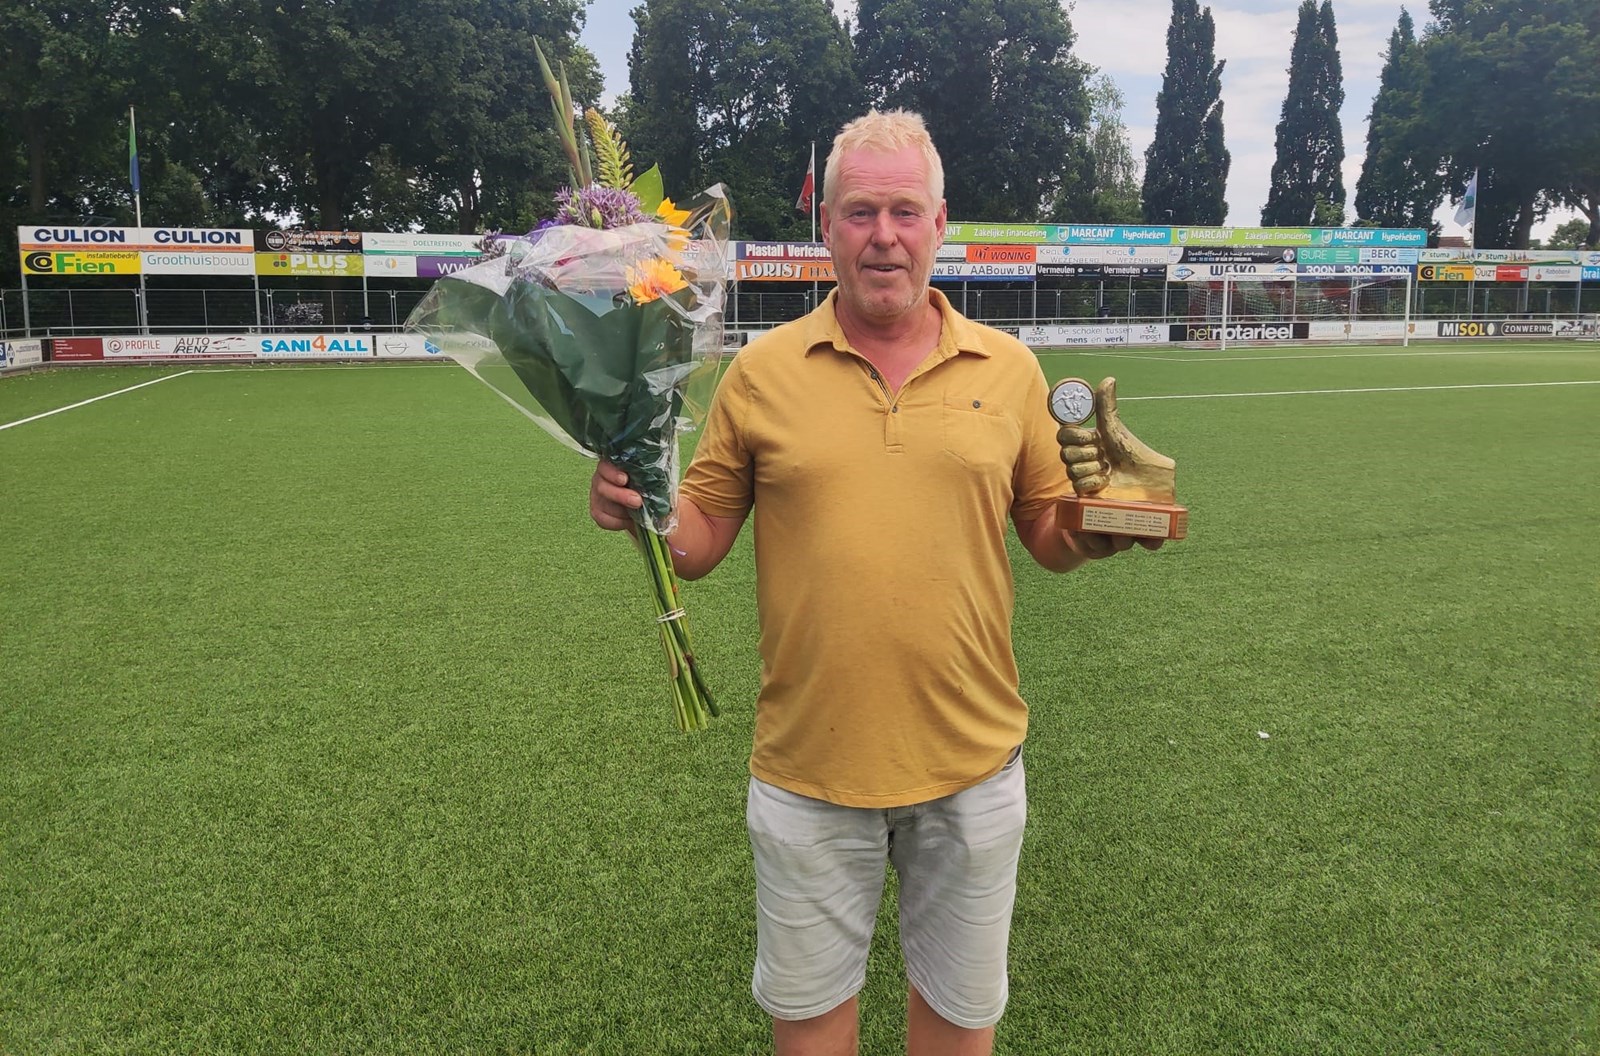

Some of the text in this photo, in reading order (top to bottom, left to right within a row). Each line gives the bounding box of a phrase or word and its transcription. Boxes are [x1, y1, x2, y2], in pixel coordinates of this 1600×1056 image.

[34, 229, 125, 242] CULION
[154, 230, 241, 244] CULION
[320, 233, 359, 241] gelegenheid
[974, 228, 1047, 238] Zakelijke financiering
[1071, 228, 1166, 240] MARCANT Hypotheken
[1190, 230, 1234, 239] MARCANT
[1244, 231, 1272, 241] Zakelijke
[1334, 231, 1421, 242] MARCANT Hypotheken
[317, 239, 333, 247] wijn!
[86, 252, 138, 260] installatiebedrijf
[991, 251, 1031, 260] WONING
[1300, 250, 1328, 260] SURE
[1371, 249, 1397, 258] BERG
[56, 254, 115, 272] Fien
[147, 254, 249, 266] Groothuisbouw
[290, 254, 348, 268] PLUS
[947, 265, 962, 275] BV
[970, 265, 1032, 275] AABouw BV
[1037, 266, 1075, 274] Vermeulen
[1103, 265, 1140, 274] Vermeulen
[1436, 266, 1464, 280] Fien
[1058, 327, 1069, 335] De
[1106, 327, 1133, 335] tussen
[1442, 322, 1485, 336] MISOL
[1504, 323, 1552, 333] ZONWERING
[125, 340, 160, 350] PROFILE
[180, 337, 210, 346] AUTO
[261, 335, 368, 352] SANI4ALL
[178, 345, 208, 353] RENZ
